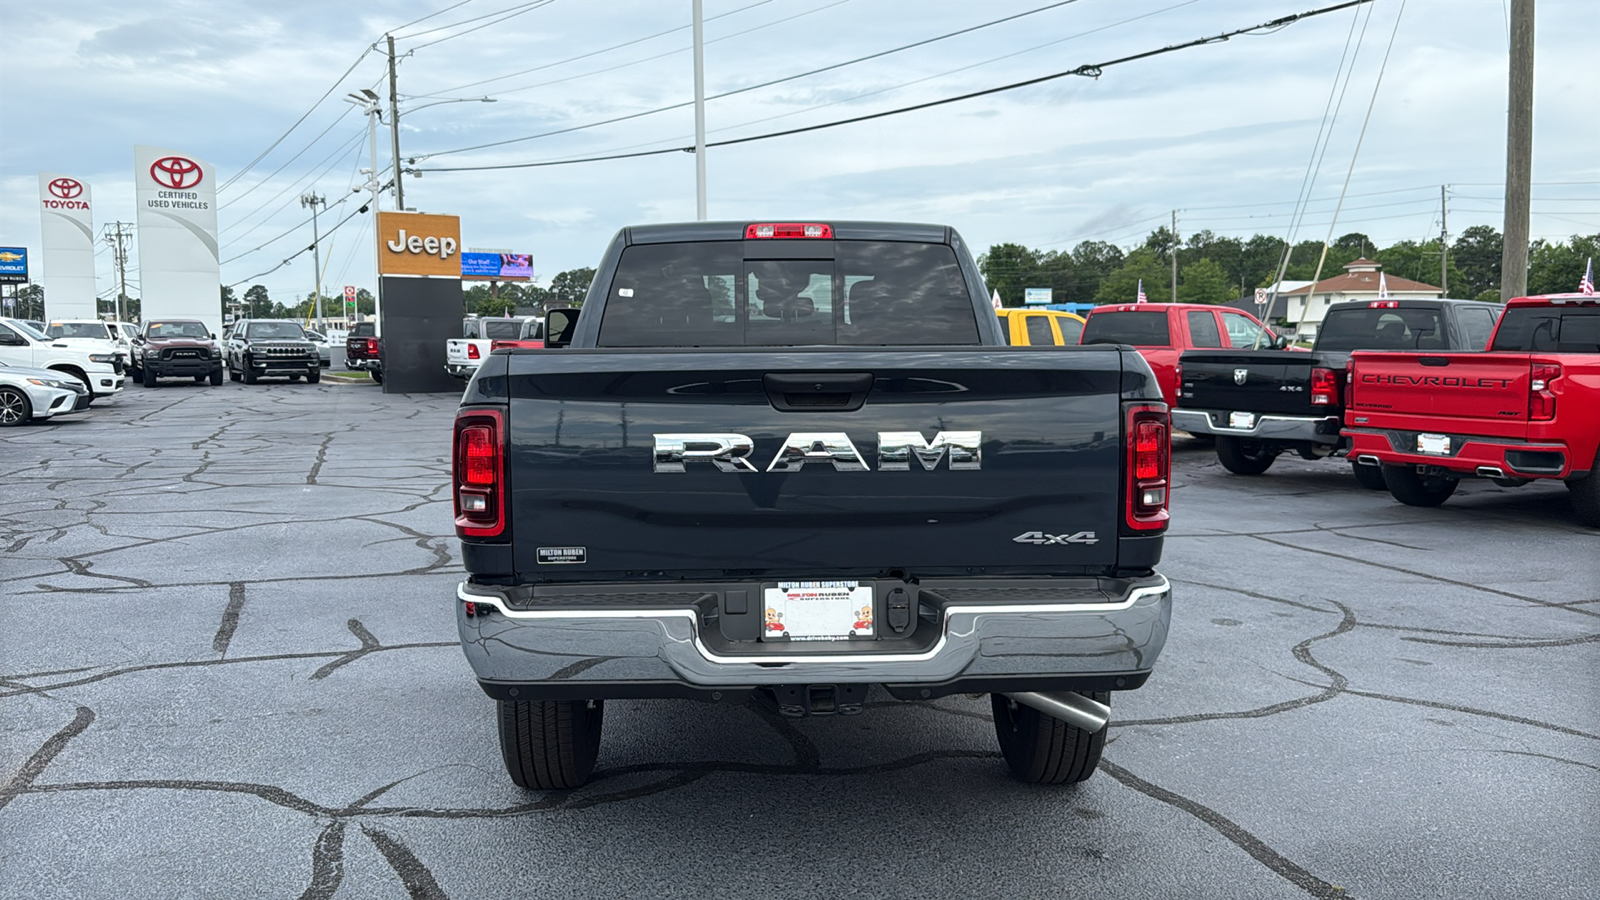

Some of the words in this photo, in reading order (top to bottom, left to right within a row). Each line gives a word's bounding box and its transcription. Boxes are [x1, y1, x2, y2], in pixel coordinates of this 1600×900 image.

[158, 190, 198, 200] CERTIFIED
[42, 199, 90, 210] TOYOTA
[147, 199, 170, 208] USED
[171, 200, 209, 210] VEHICLES
[387, 229, 457, 259] Jeep
[1362, 374, 1513, 389] CHEVROLET
[653, 431, 983, 474] RAM
[778, 581, 800, 589] MILTON
